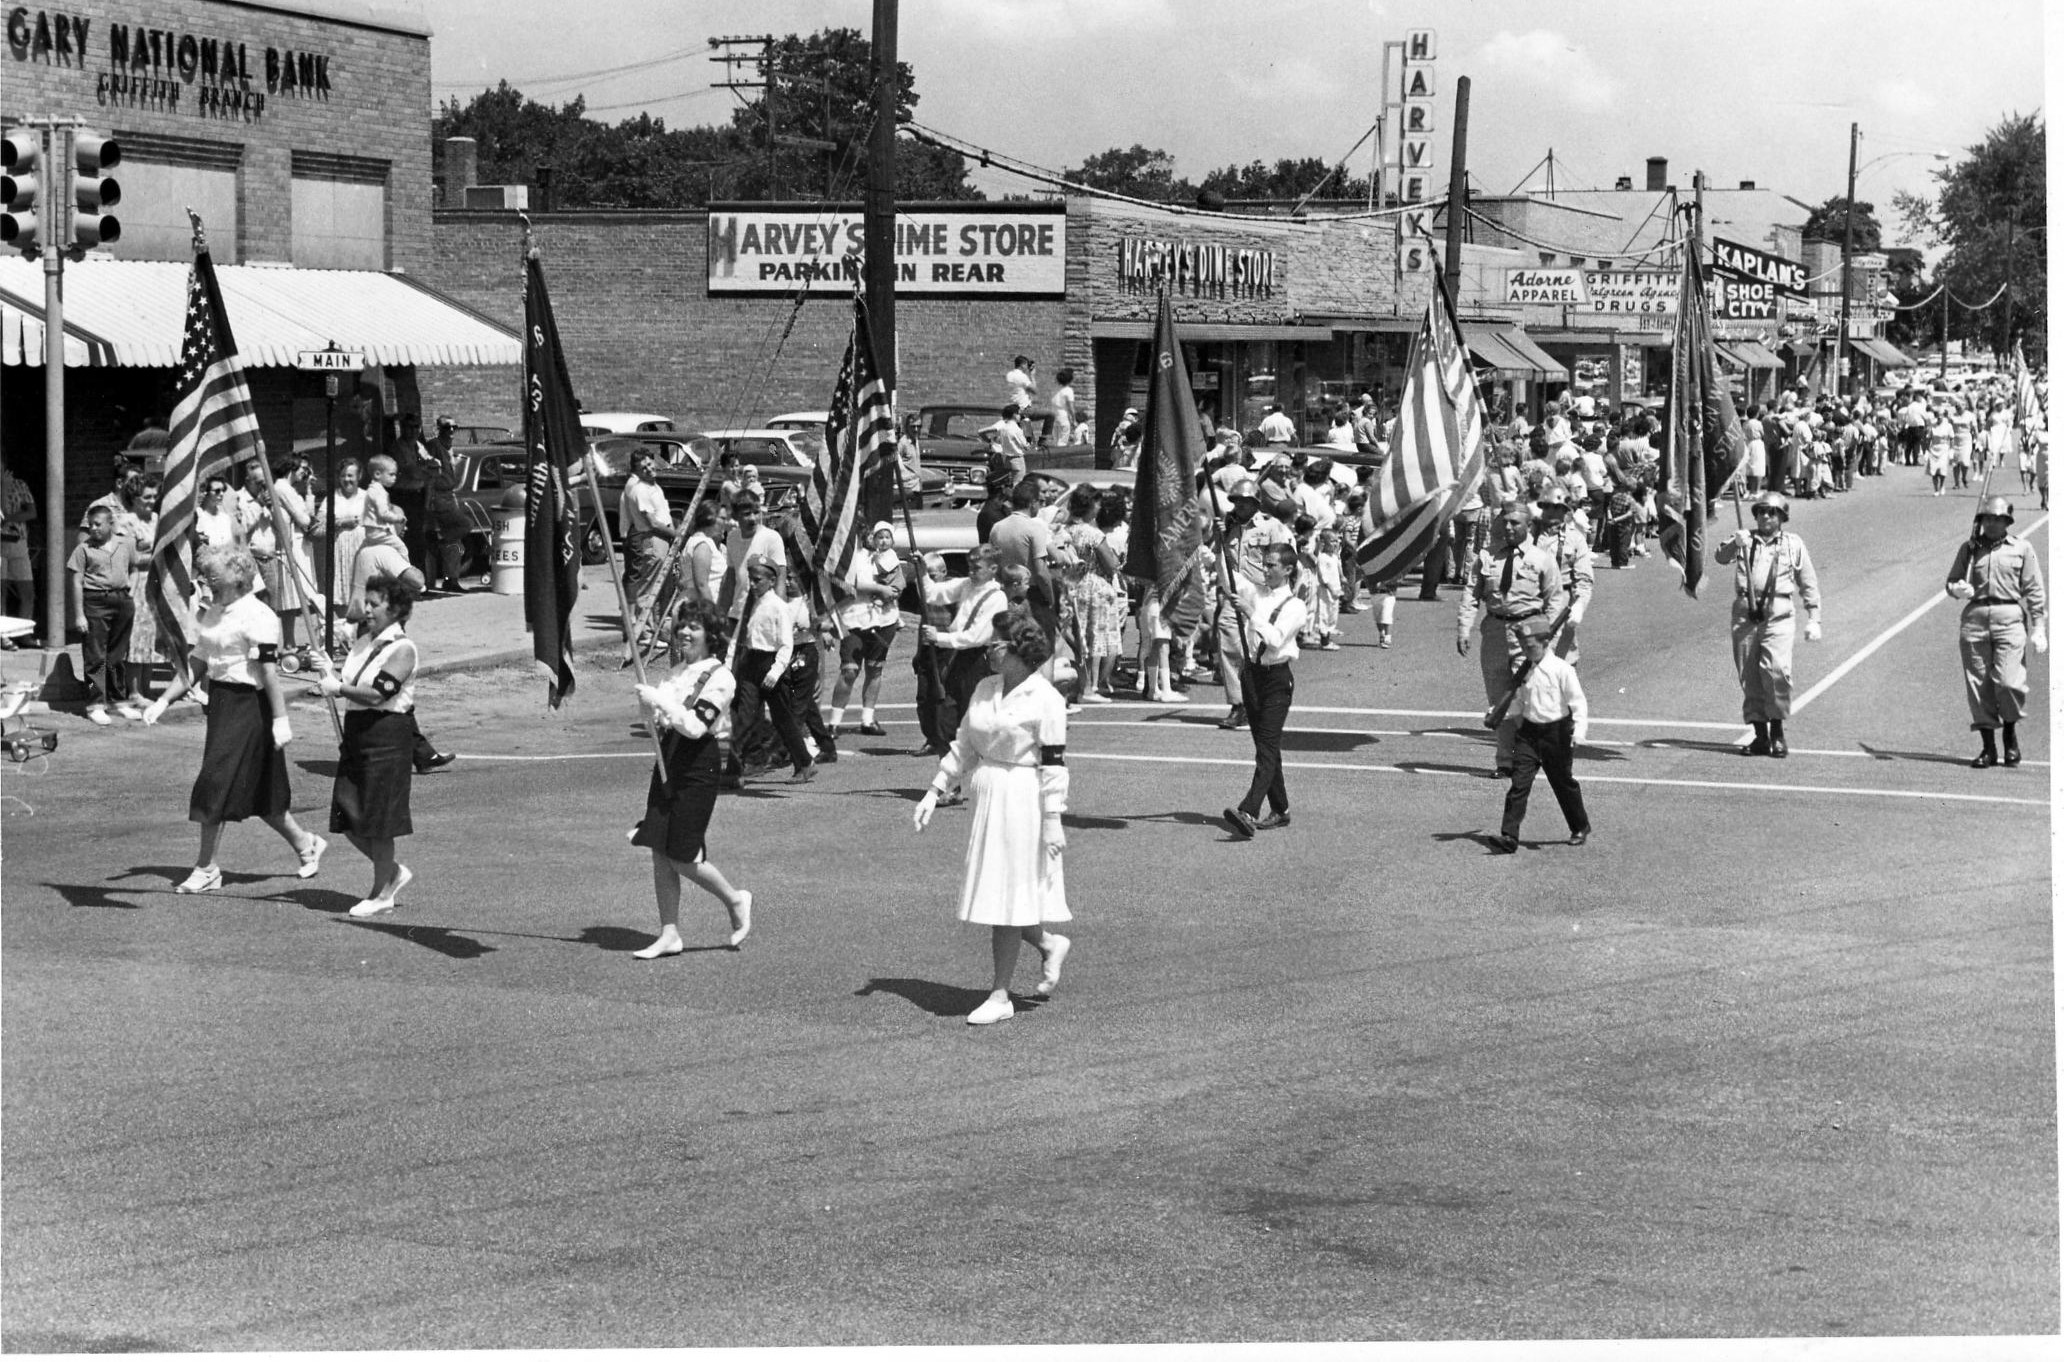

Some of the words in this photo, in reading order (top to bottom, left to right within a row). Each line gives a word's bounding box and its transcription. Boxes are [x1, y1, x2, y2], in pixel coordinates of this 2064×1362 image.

[8, 6, 91, 60] GARY
[110, 22, 253, 81] NATIONAL
[265, 46, 332, 93] BANK
[99, 72, 180, 104] GRIFFITH
[202, 84, 265, 115] BRANCH
[1404, 32, 1429, 271] HARVEYS
[710, 216, 865, 278] HARVEY'S
[896, 222, 947, 257] IME
[959, 223, 1054, 257] STORE
[759, 262, 866, 281] PARKIN
[931, 263, 1006, 283] REAR
[1199, 244, 1232, 282] DIME
[1238, 248, 1277, 287] STORE
[1717, 244, 1806, 291] KAPLAN'S
[1509, 271, 1575, 287] Adorne
[1586, 273, 1678, 286] GRIFFITH
[1509, 289, 1578, 302] APPAREL
[1590, 286, 1634, 300] algreen
[1726, 284, 1775, 300] SHOE
[1594, 300, 1667, 313] DRUGS
[1728, 301, 1772, 317] CITY
[313, 354, 350, 367] MAIN
